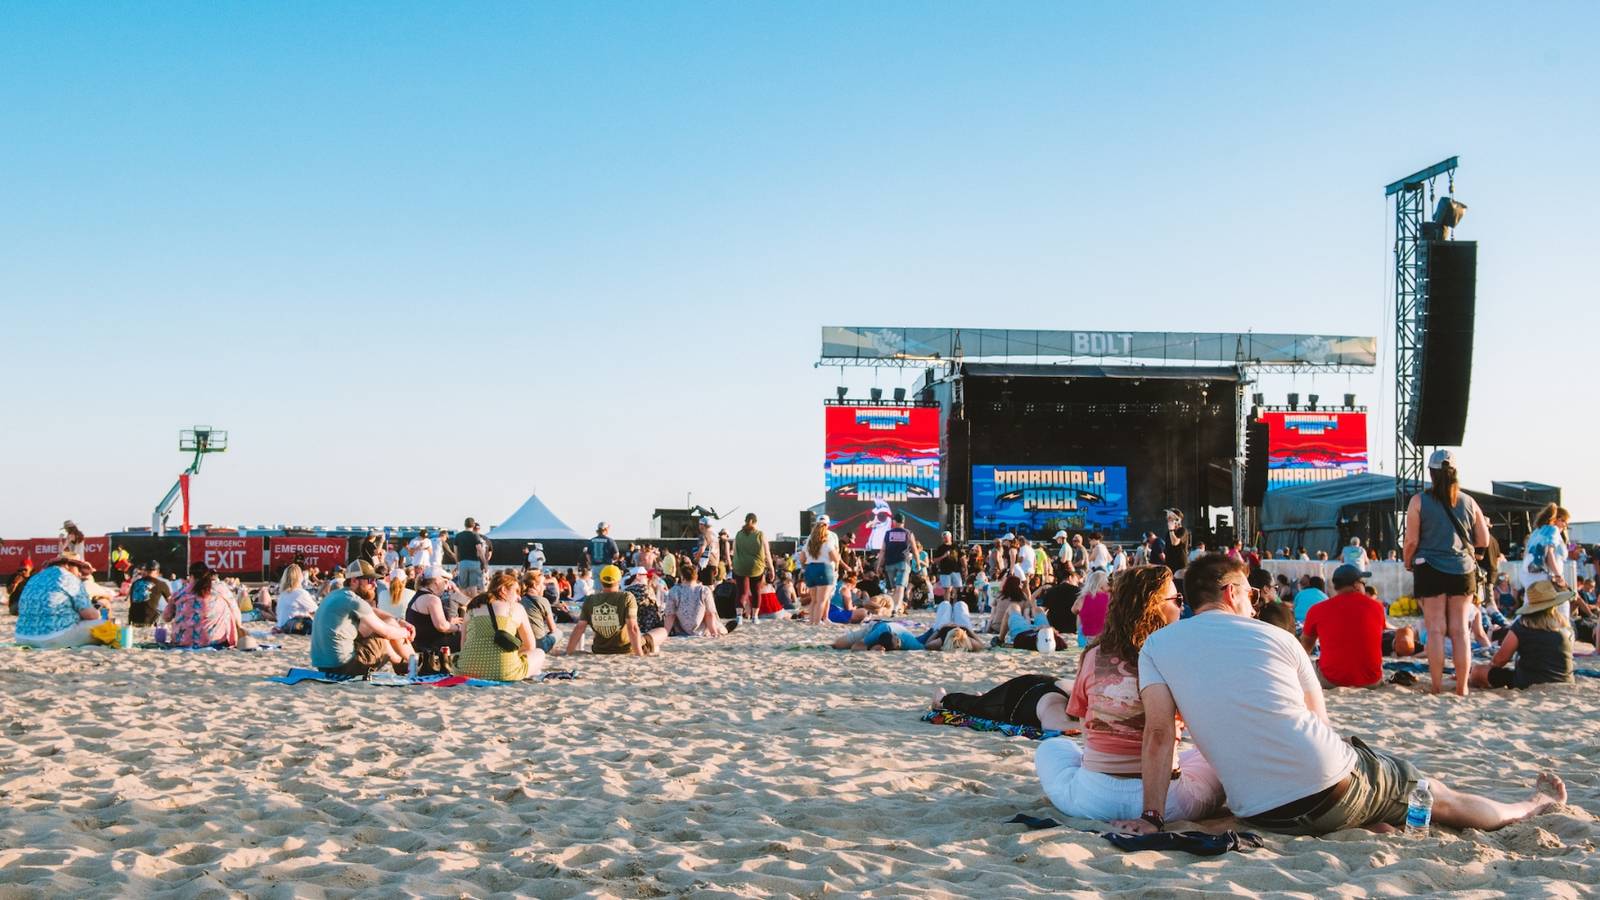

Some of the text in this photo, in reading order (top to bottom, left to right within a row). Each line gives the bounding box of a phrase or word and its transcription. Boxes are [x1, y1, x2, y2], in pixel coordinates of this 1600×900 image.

[1074, 333, 1133, 354] BOLT
[858, 482, 907, 501] ROCK
[994, 468, 1105, 502] BOARDWALK
[1024, 489, 1078, 510] ROCK
[35, 543, 104, 554] EMECY
[205, 539, 246, 547] EMERGENCY
[274, 544, 341, 553] EMERGENCY
[205, 550, 246, 569] EXIT
